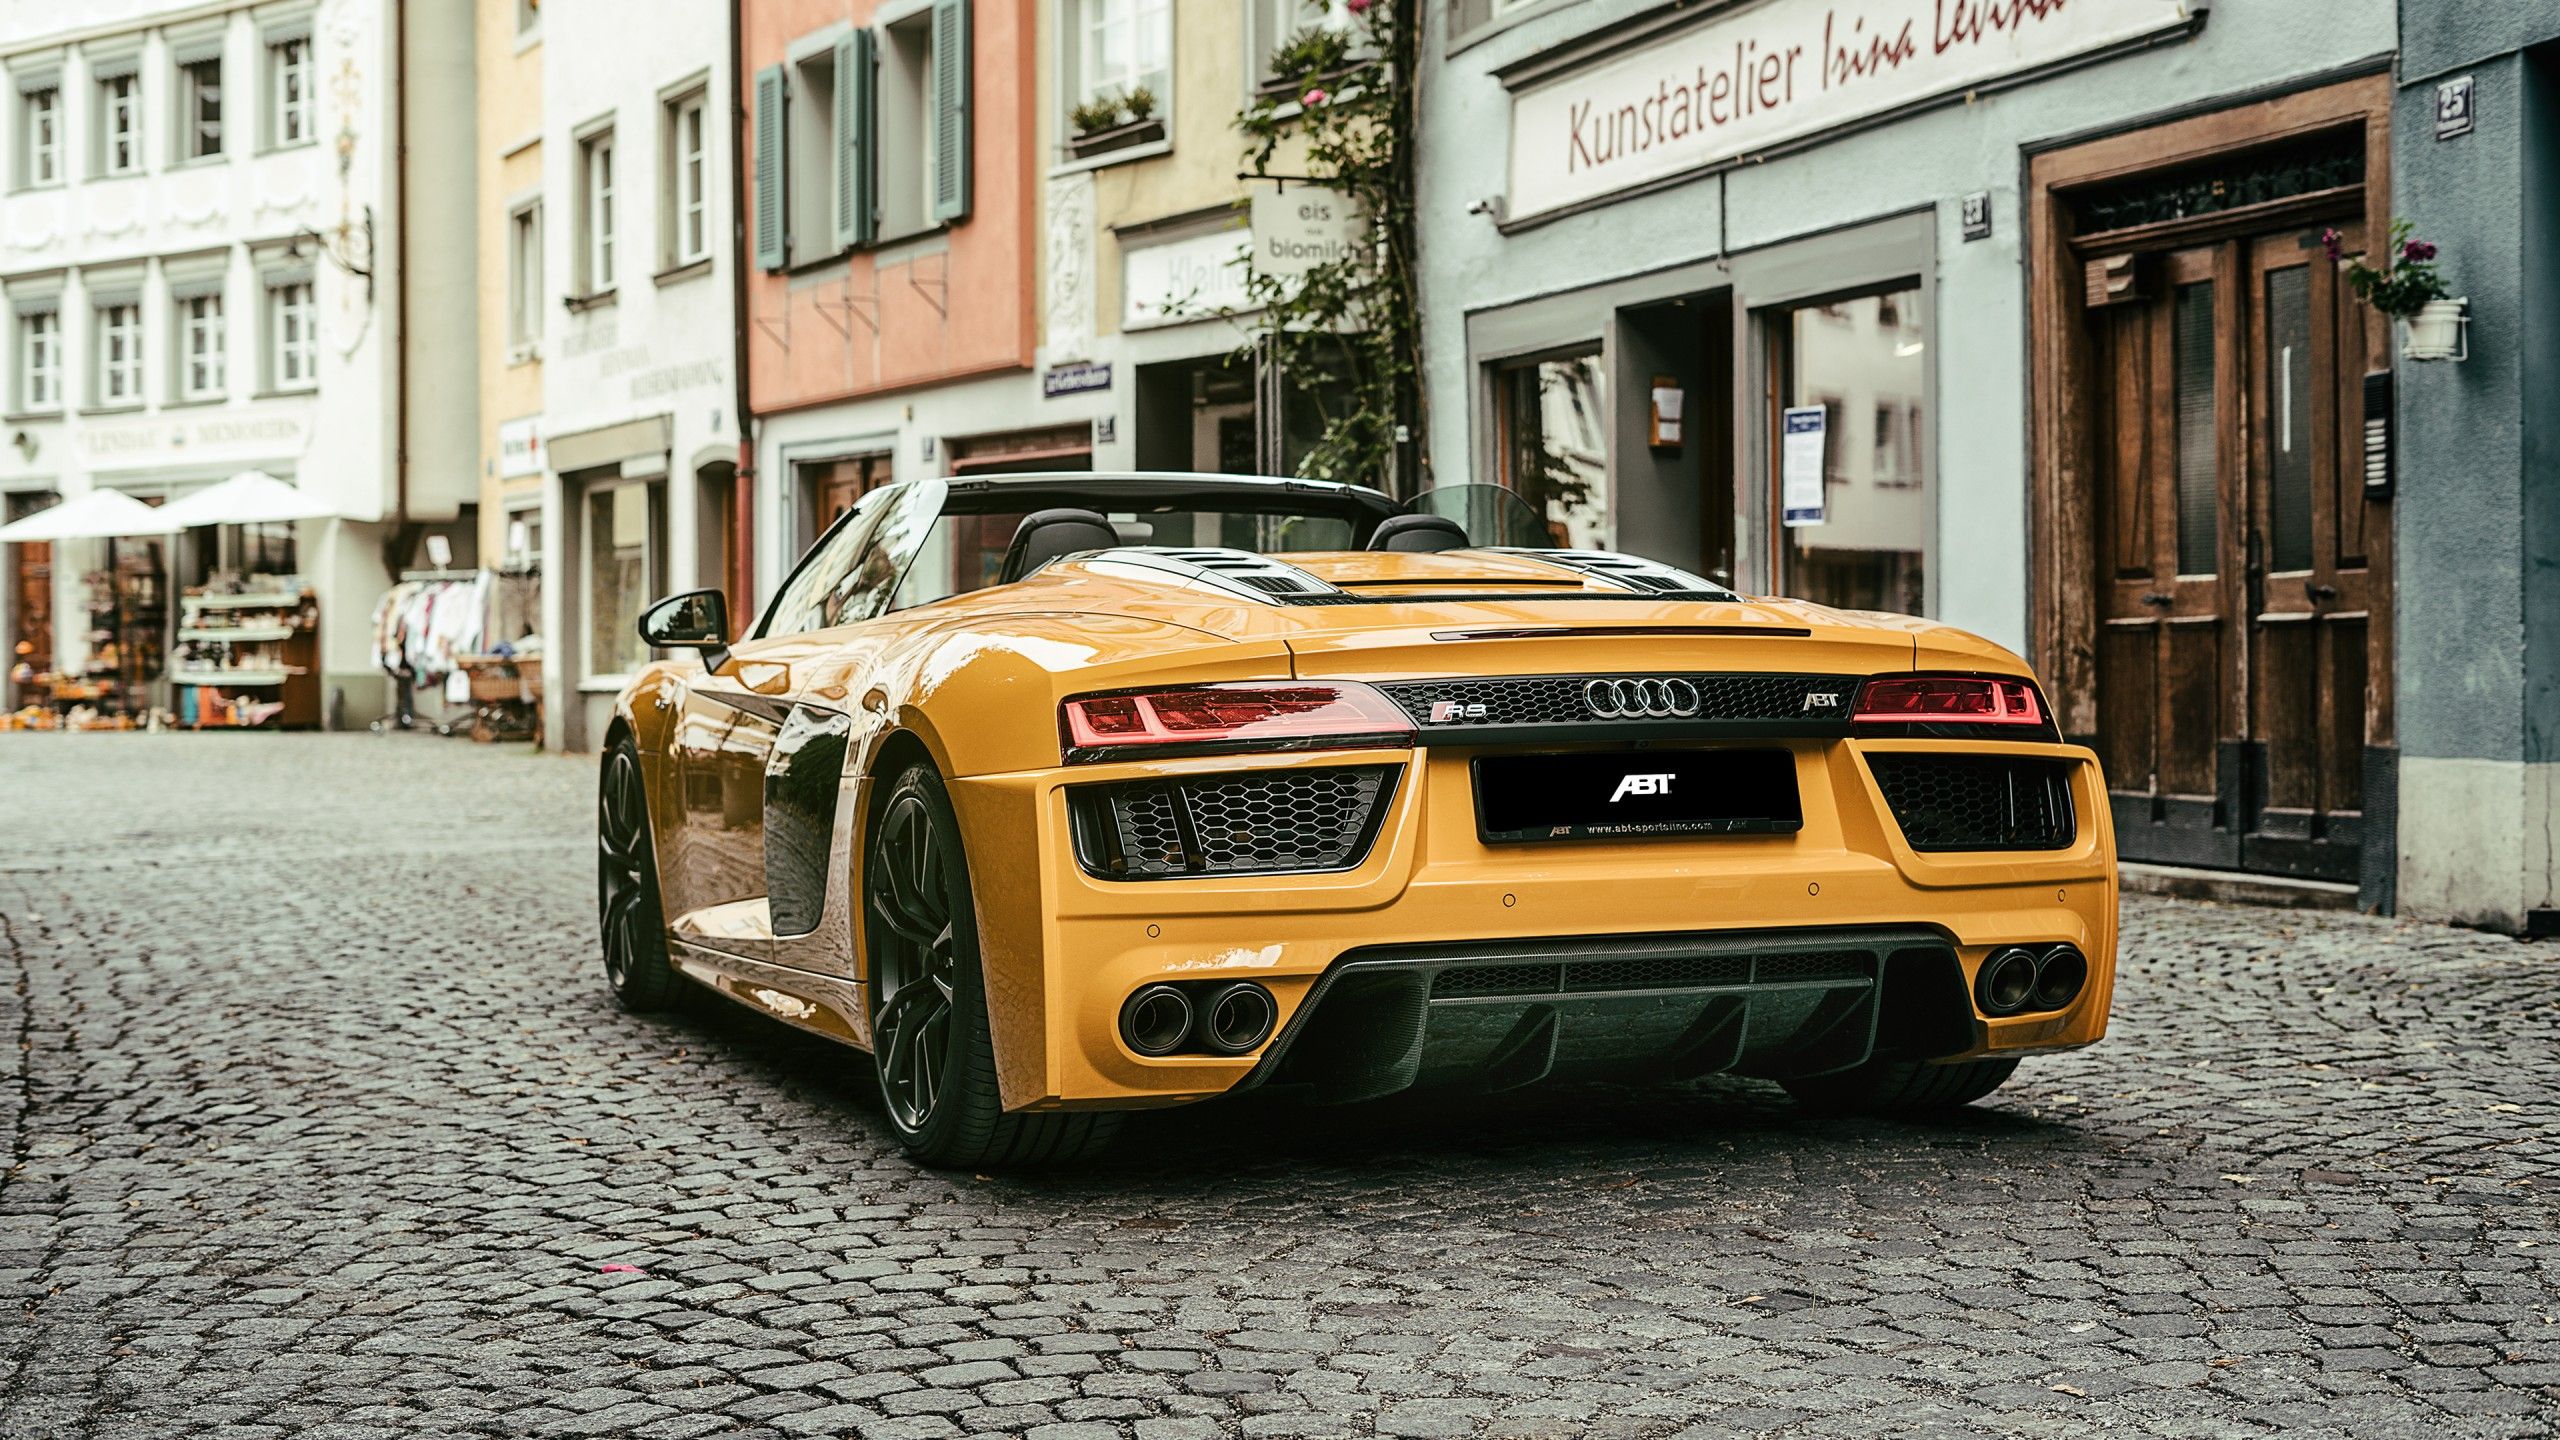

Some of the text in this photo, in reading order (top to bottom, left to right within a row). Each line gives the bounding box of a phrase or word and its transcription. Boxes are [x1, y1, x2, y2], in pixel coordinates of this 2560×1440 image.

[1568, 39, 1802, 174] Kunstatelier
[1823, 9, 1917, 91] Irina
[2440, 86, 2466, 119] 25
[1298, 201, 1331, 221] eis
[1269, 235, 1362, 260] biomilch
[1443, 703, 1487, 719] R8
[1803, 693, 1839, 711] ABT
[1609, 773, 1676, 802] ABT
[1550, 825, 1572, 837] ABT
